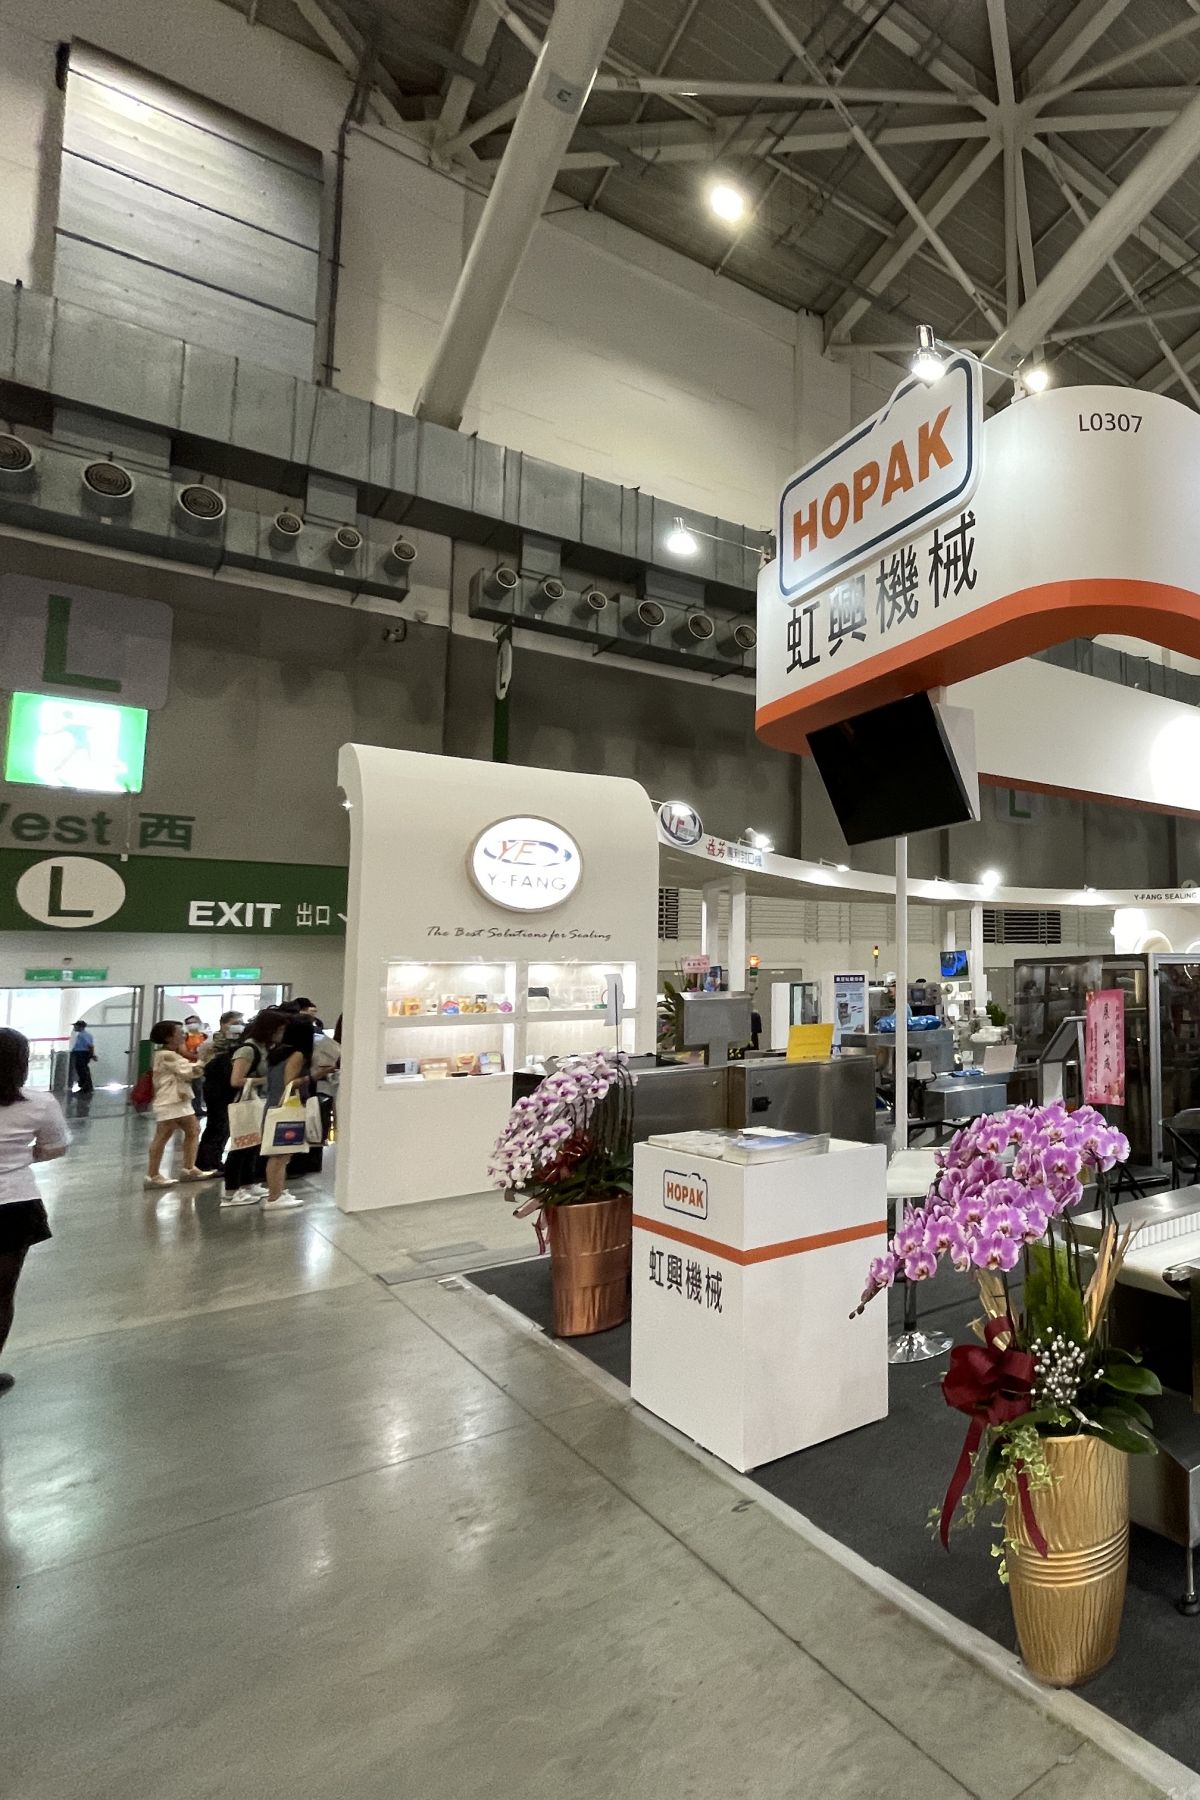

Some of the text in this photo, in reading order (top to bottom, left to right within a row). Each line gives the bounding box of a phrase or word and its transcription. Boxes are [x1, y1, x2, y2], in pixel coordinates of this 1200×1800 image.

[1078, 412, 1143, 433] L0307
[793, 404, 953, 561] HOPAK
[786, 510, 978, 674] 虹興機械
[42, 594, 122, 693] L
[138, 812, 196, 851] 西
[47, 866, 94, 918] L
[488, 872, 567, 890] Y-FANG
[1134, 892, 1197, 901] Y-FANG SEALING
[188, 901, 330, 928] EXIT 出口
[426, 925, 611, 943] The Best Solutions for Sealing
[666, 1181, 704, 1209] HOPAK
[649, 1245, 723, 1314] 虹興機械
